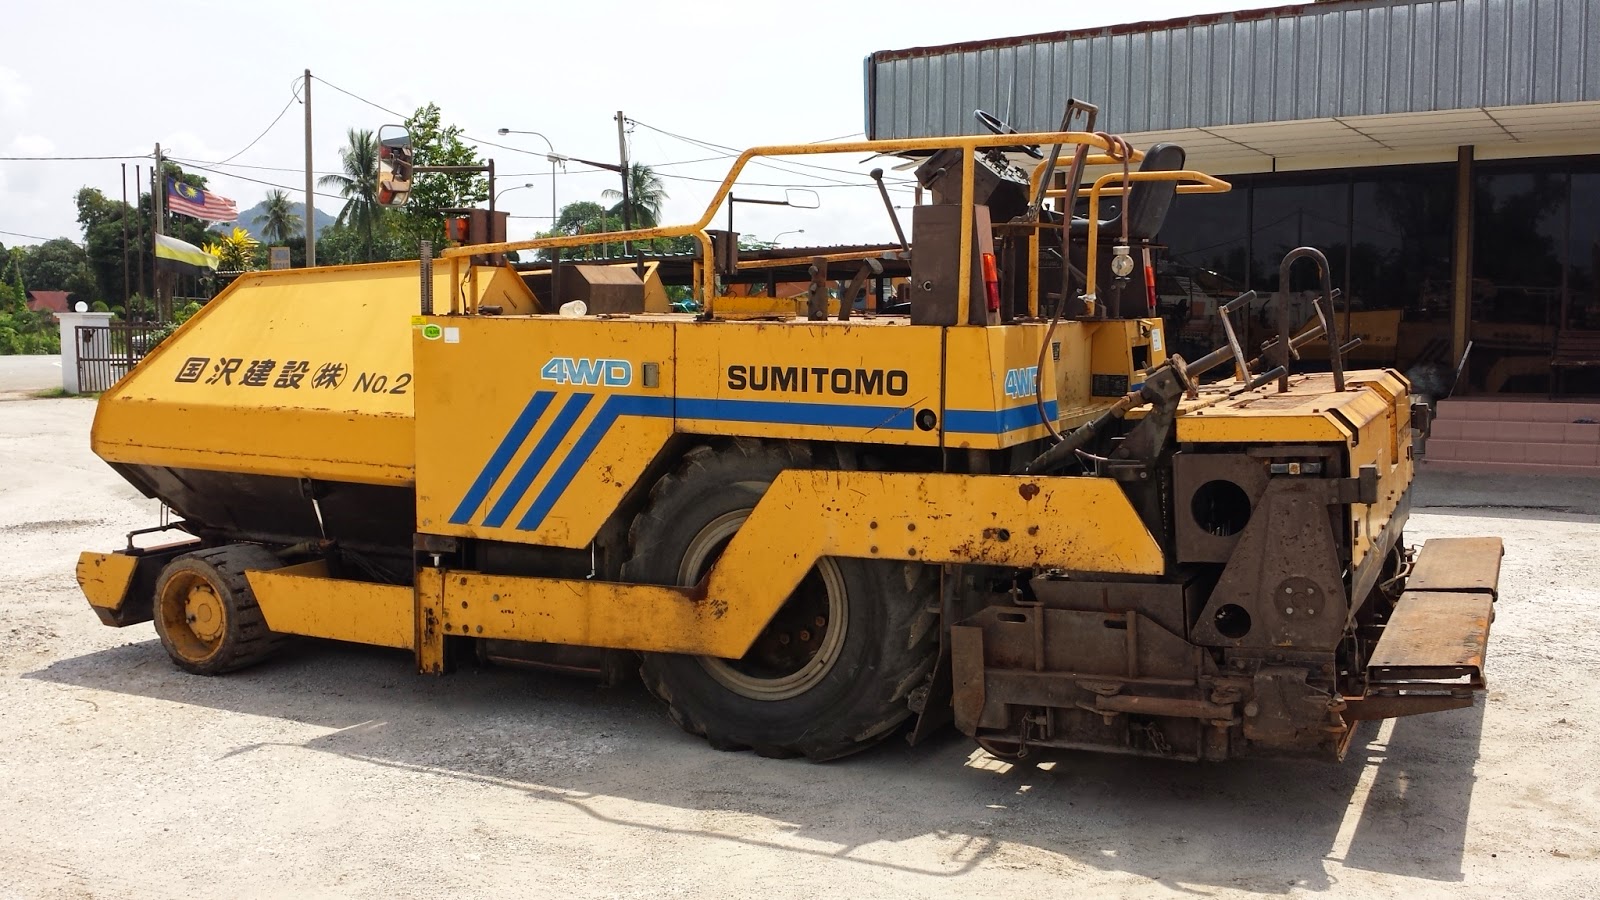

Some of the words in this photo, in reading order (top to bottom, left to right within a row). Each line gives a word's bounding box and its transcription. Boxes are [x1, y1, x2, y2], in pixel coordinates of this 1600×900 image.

[352, 372, 412, 395] No.2
[541, 357, 633, 388] 4WD
[727, 365, 908, 397] SUMITOMO
